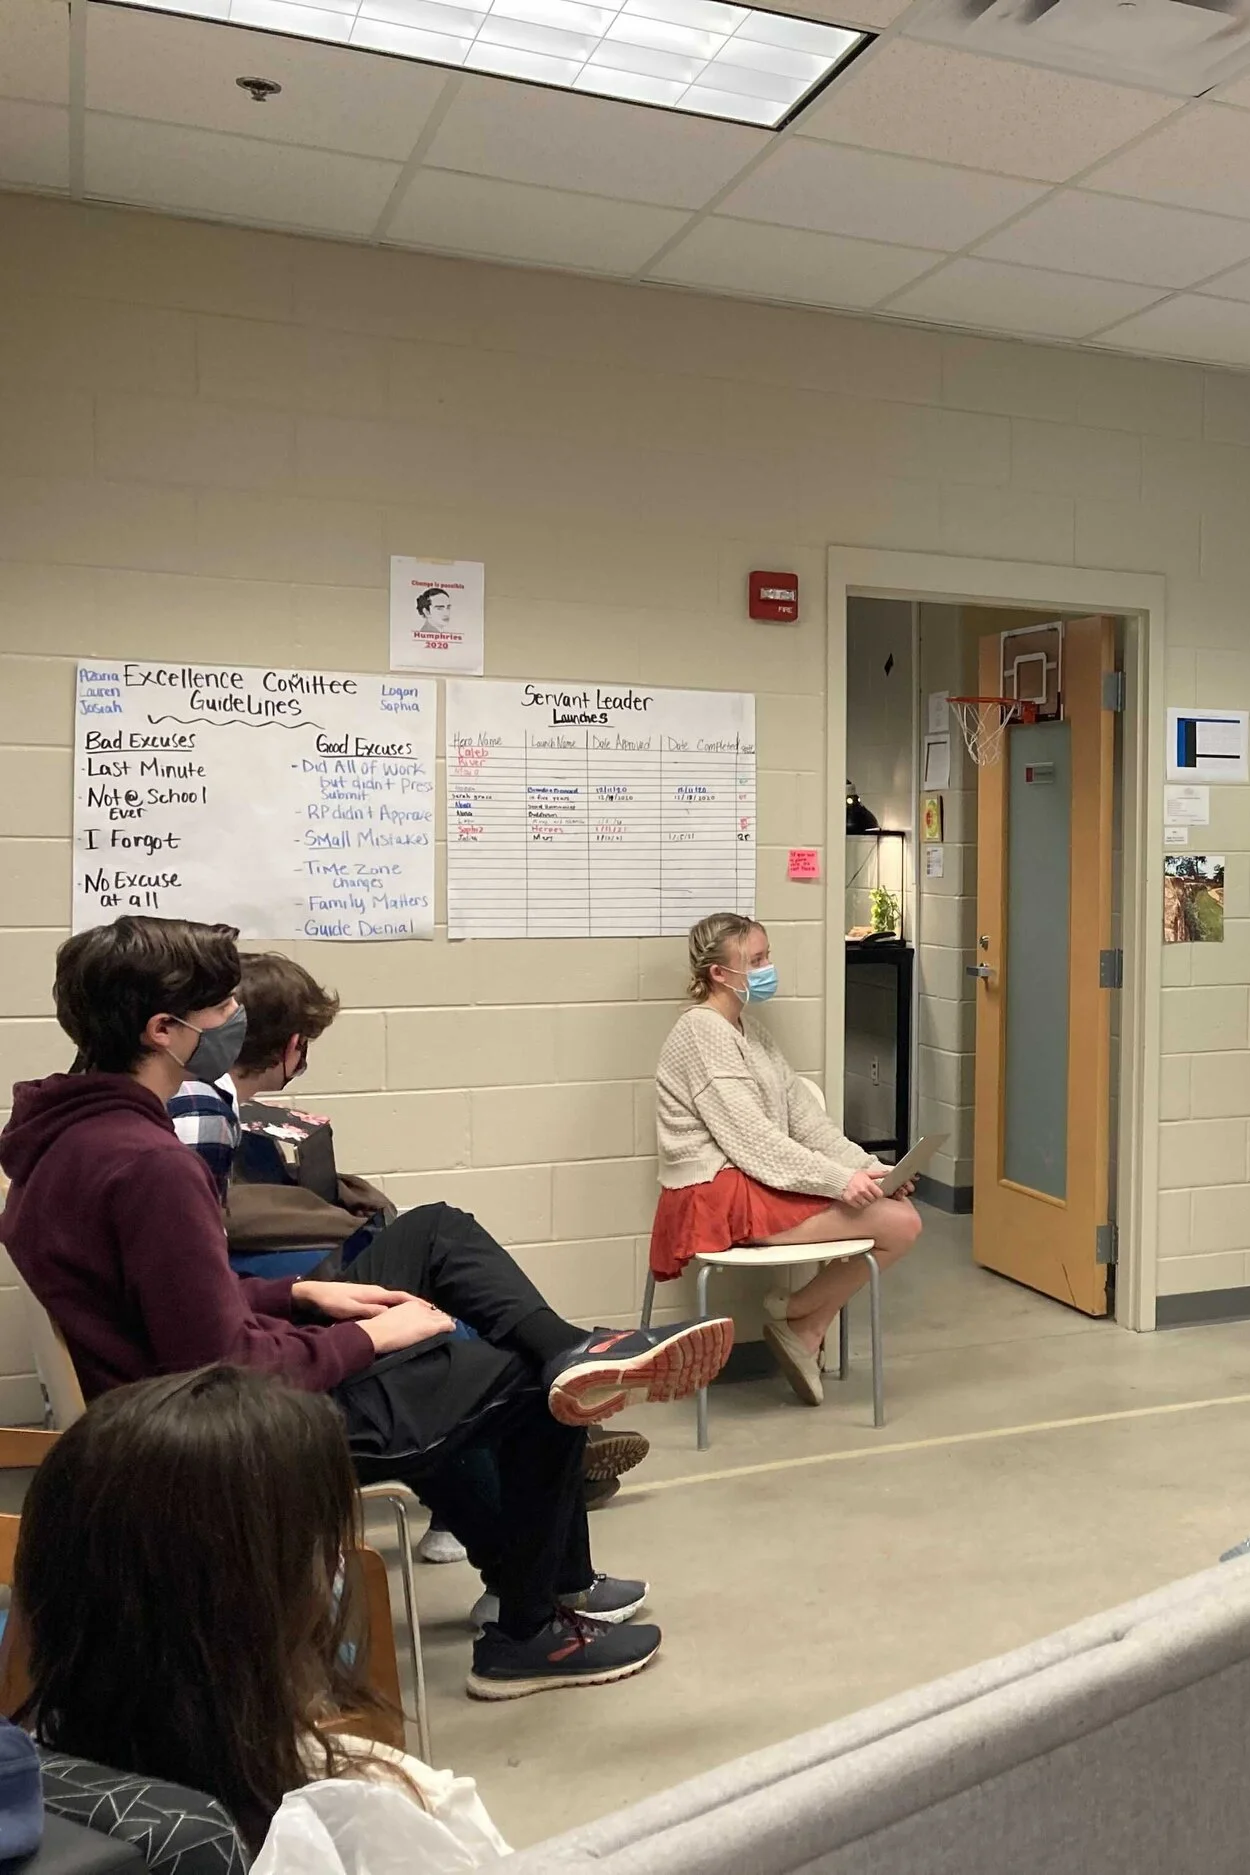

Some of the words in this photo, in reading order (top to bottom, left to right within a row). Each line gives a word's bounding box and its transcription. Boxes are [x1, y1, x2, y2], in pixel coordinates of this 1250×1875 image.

[413, 631, 462, 640] Humphries
[425, 641, 449, 649] 2020
[124, 664, 244, 689] Excellence
[79, 687, 120, 698] Lauren
[382, 684, 418, 700] Logan
[521, 684, 591, 710] Servant
[597, 689, 654, 711] Leader
[79, 700, 122, 715] Josiah
[380, 700, 420, 713] Sophia
[553, 709, 608, 725] Launches
[85, 730, 122, 750] Bad
[129, 733, 196, 749] Excuses
[316, 733, 349, 754] Good
[355, 737, 412, 756] Excuses
[593, 735, 611, 750] Date
[667, 736, 689, 751] Date
[458, 746, 489, 758] Caleb
[88, 757, 131, 777] Last
[141, 757, 206, 778] Minute
[335, 759, 356, 774] All
[87, 784, 120, 808] Not
[147, 787, 207, 804] School
[308, 804, 330, 819] RP
[85, 829, 100, 851] I
[111, 829, 182, 856] Forgot
[84, 868, 109, 893] No
[115, 869, 182, 888] Excuse
[100, 892, 122, 907] at
[129, 892, 158, 909] all
[309, 893, 366, 915] Family
[372, 893, 429, 910] Matters
[304, 919, 352, 937] Guide
[358, 918, 414, 937] Denial
